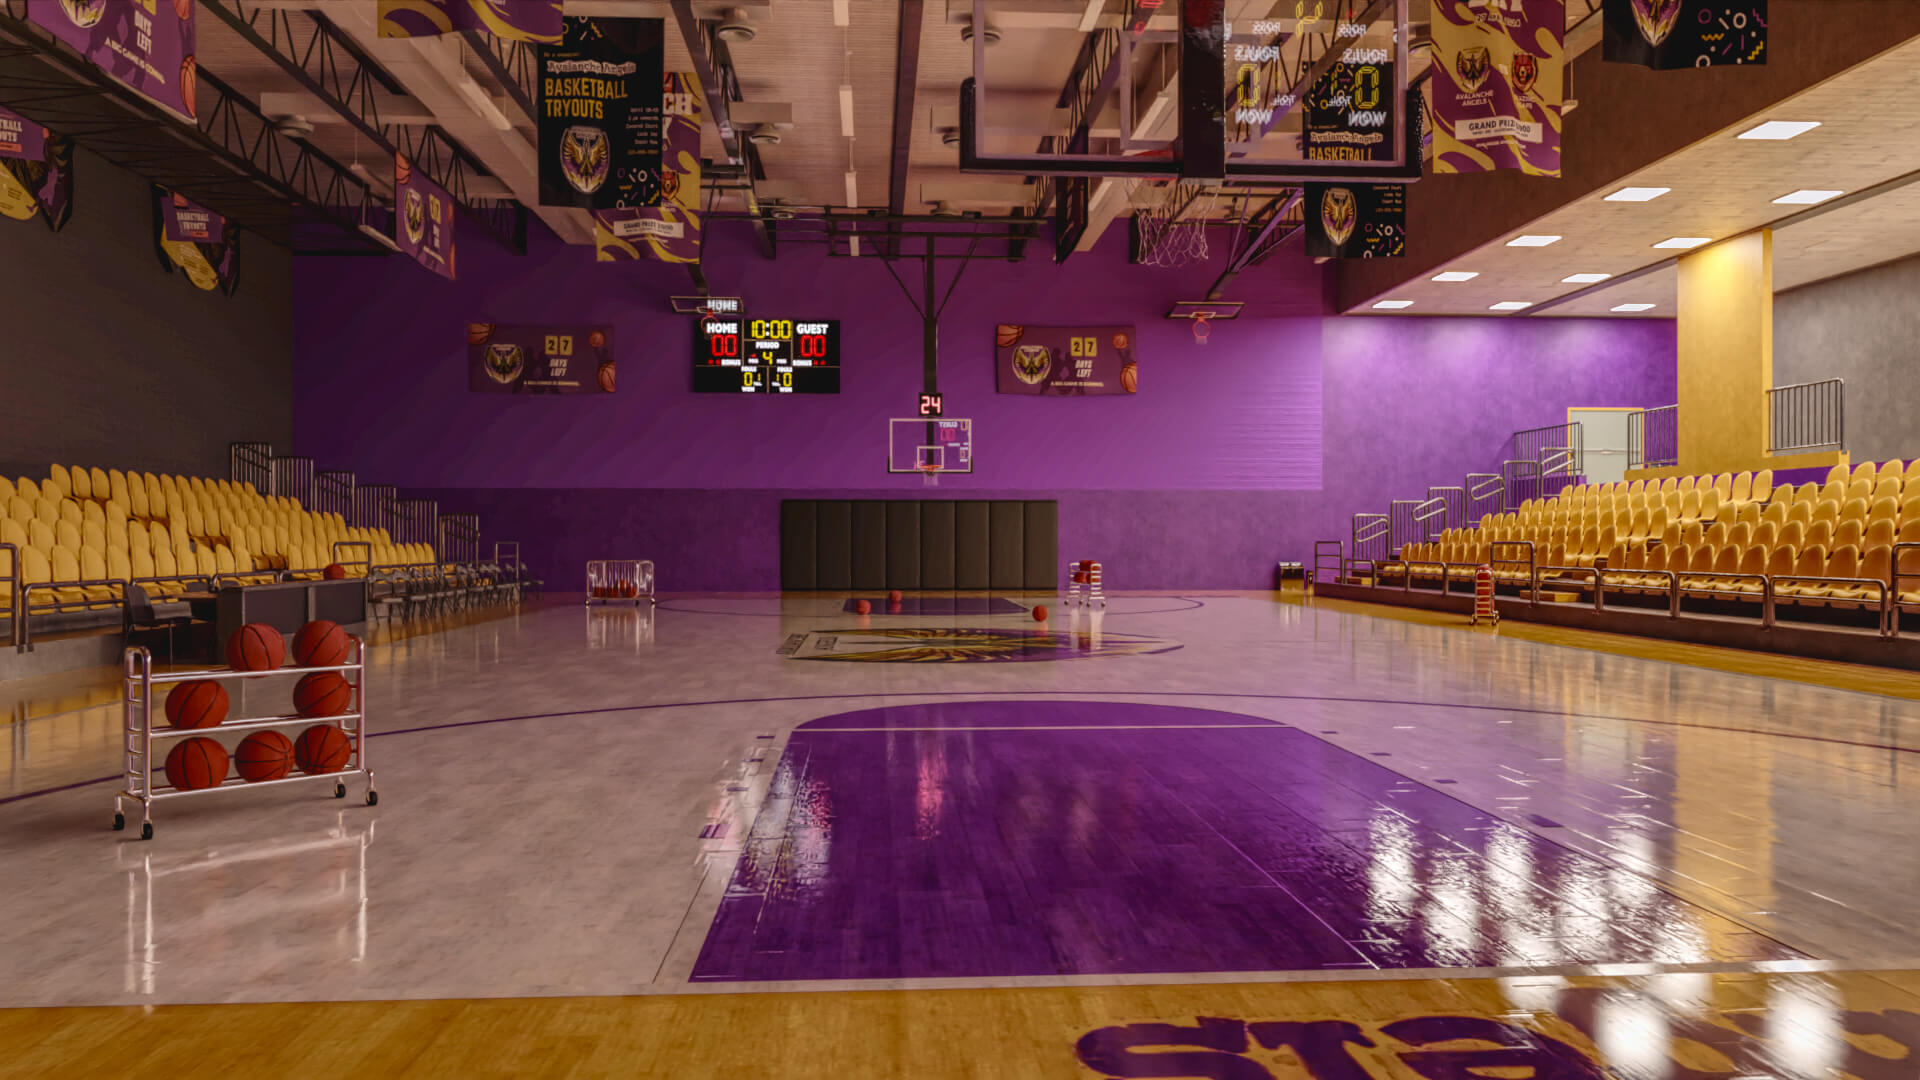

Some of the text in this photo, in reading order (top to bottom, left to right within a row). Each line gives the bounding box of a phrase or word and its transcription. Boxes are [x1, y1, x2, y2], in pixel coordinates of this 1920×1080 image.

[544, 77, 629, 100] BASKETBALL
[544, 98, 603, 119] TRYOUTS
[1469, 121, 1497, 131] GRAND
[707, 299, 738, 311] HOME
[706, 320, 829, 339] HOME 10:00 GUEST
[548, 340, 569, 351] 27
[712, 334, 738, 357] 00
[755, 341, 780, 350] PERIOD
[801, 334, 826, 358] 00
[1073, 341, 1094, 353] 27
[762, 351, 773, 365] 4
[743, 371, 753, 386] 0
[782, 372, 793, 387] 0
[920, 395, 941, 415] 24
